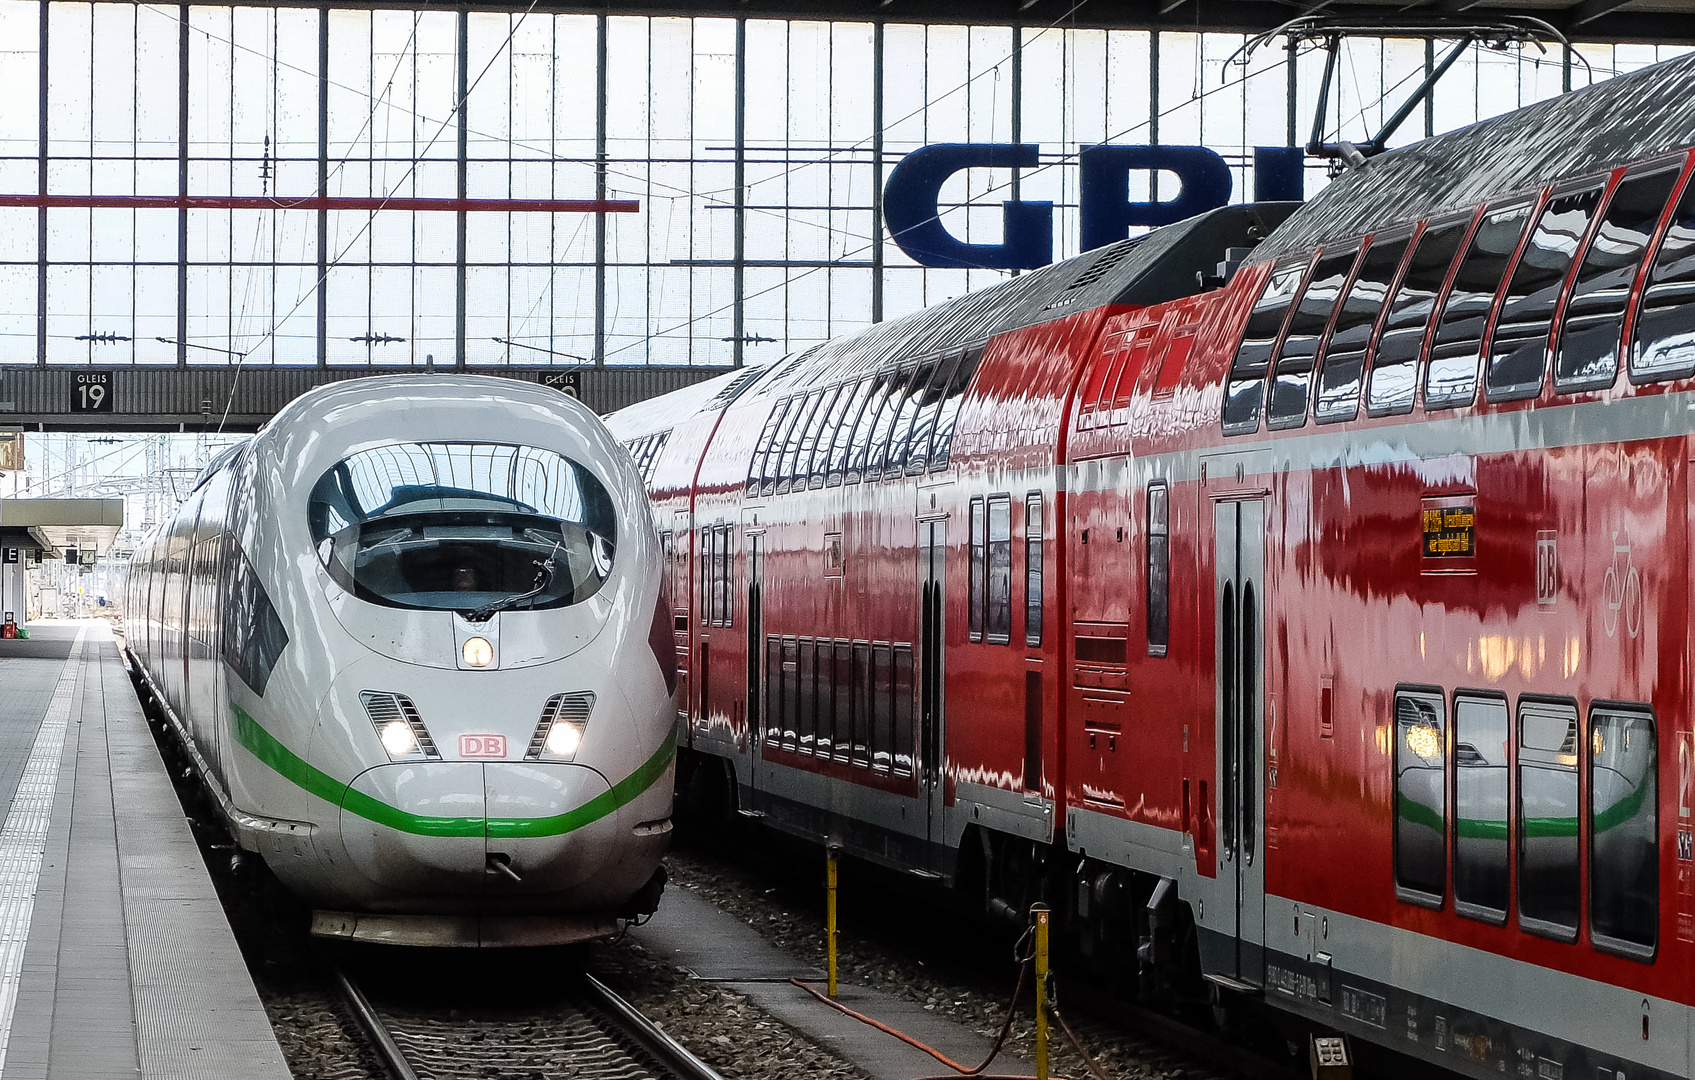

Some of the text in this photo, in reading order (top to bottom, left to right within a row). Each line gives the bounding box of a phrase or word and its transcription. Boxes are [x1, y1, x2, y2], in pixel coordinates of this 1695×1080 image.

[77, 374, 107, 383] GLEIS
[545, 375, 575, 384] GLEIS
[79, 384, 105, 409] 19
[1539, 544, 1556, 600] DB
[463, 736, 502, 755] DB
[1678, 739, 1691, 818] 2
